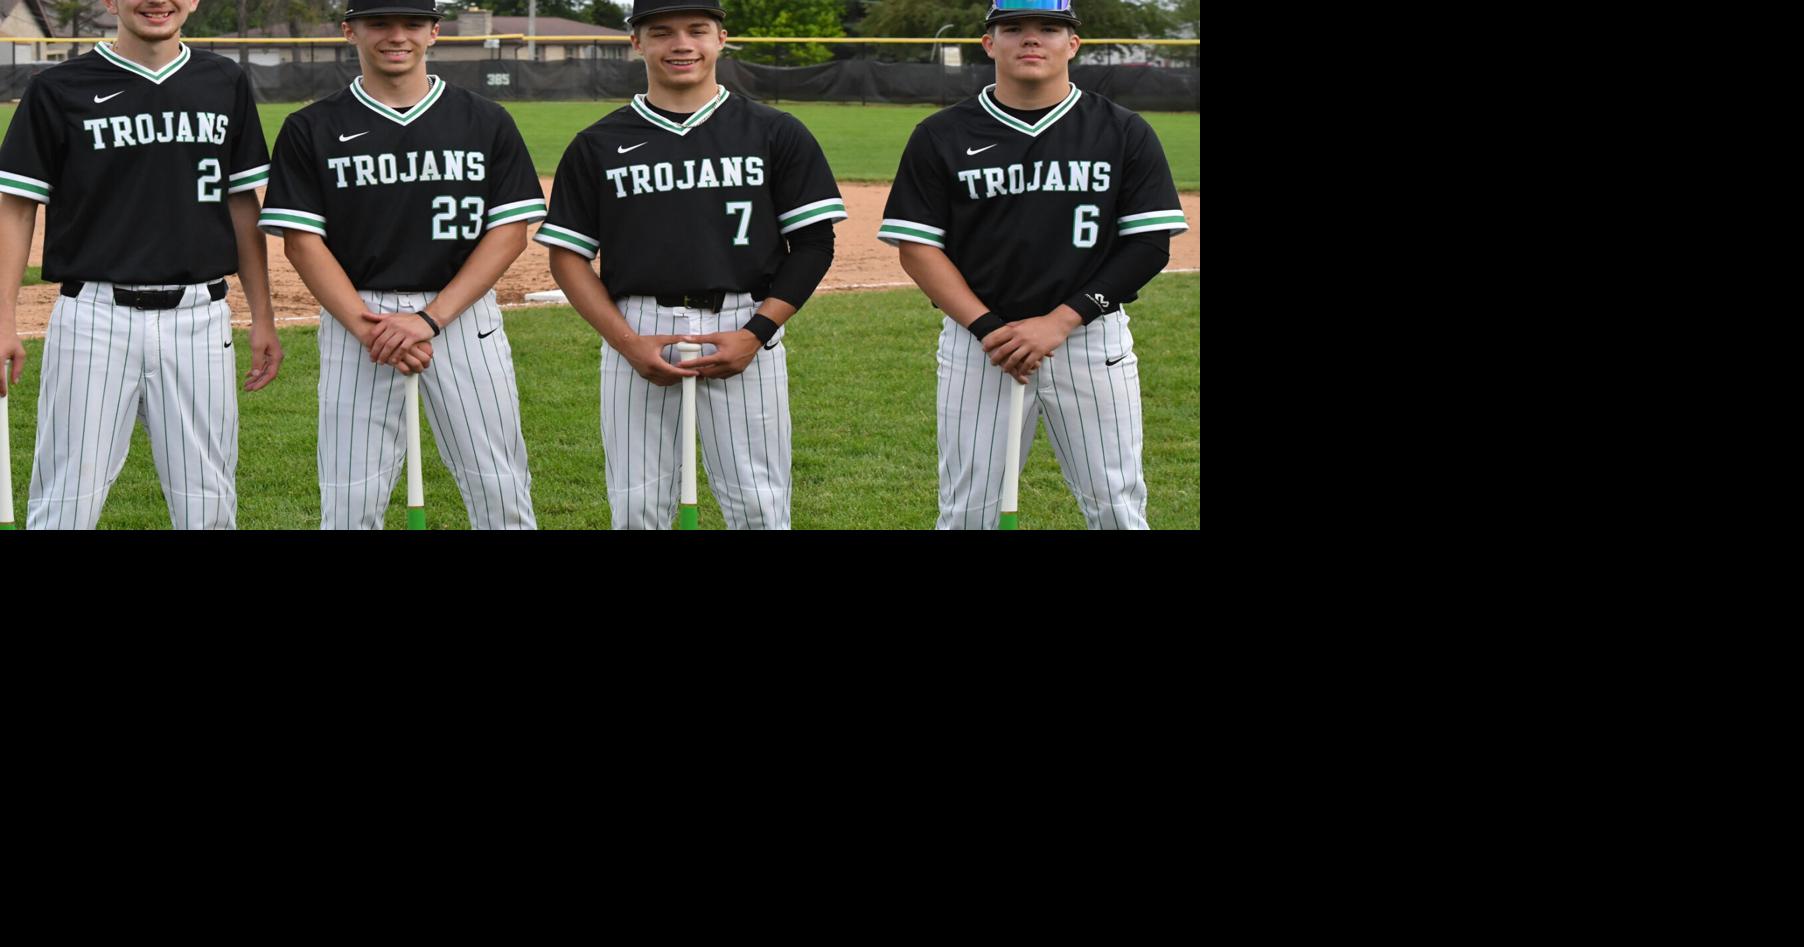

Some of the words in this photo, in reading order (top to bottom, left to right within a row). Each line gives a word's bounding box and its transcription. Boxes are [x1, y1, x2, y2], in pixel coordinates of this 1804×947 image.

[82, 110, 230, 151] TROJANS
[196, 156, 223, 204] 2
[326, 149, 487, 190] TROJANS
[604, 155, 766, 200] TROJANS
[956, 159, 1113, 201] TROJANS
[430, 194, 486, 242] 23
[724, 200, 754, 247] 7
[1071, 203, 1102, 250] 6
